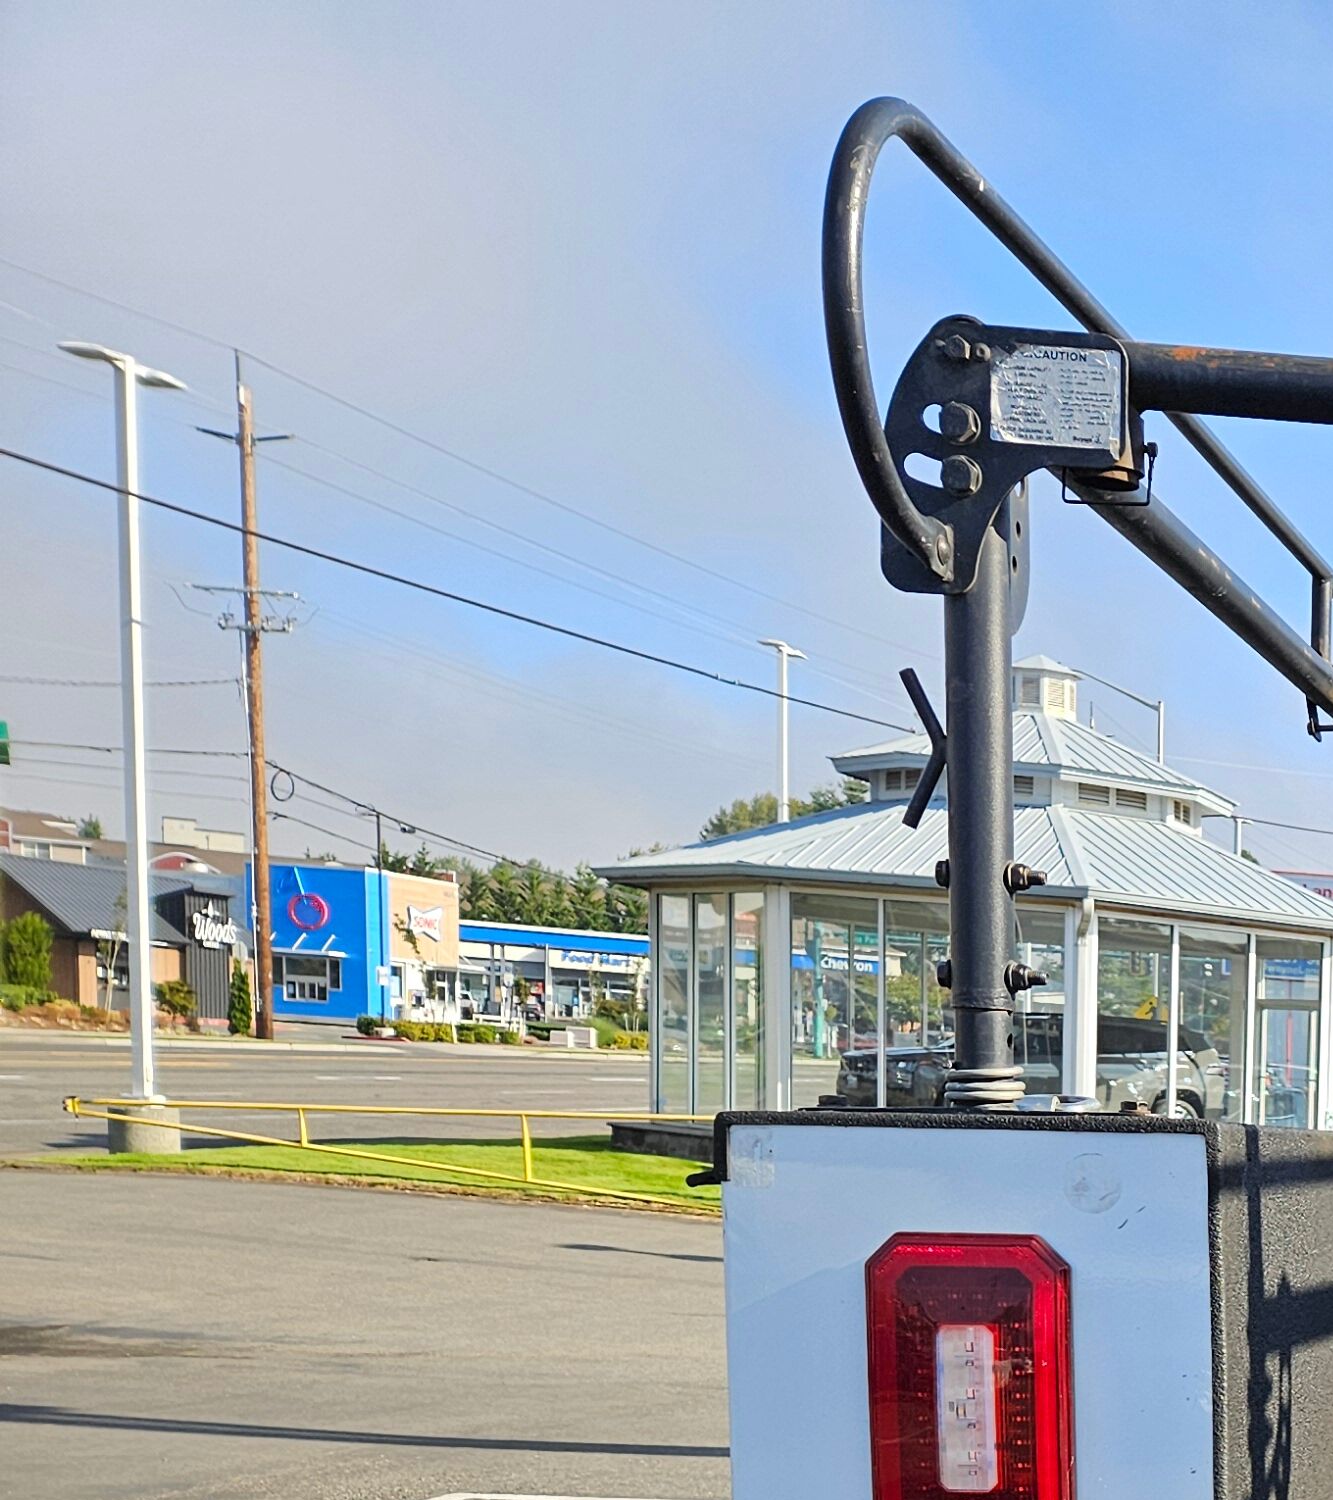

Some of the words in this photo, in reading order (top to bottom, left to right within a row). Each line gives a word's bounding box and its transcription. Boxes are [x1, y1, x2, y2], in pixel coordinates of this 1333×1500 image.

[1033, 350, 1087, 362] CAUTION
[192, 912, 237, 944] Woods
[820, 956, 873, 973] Chevon
